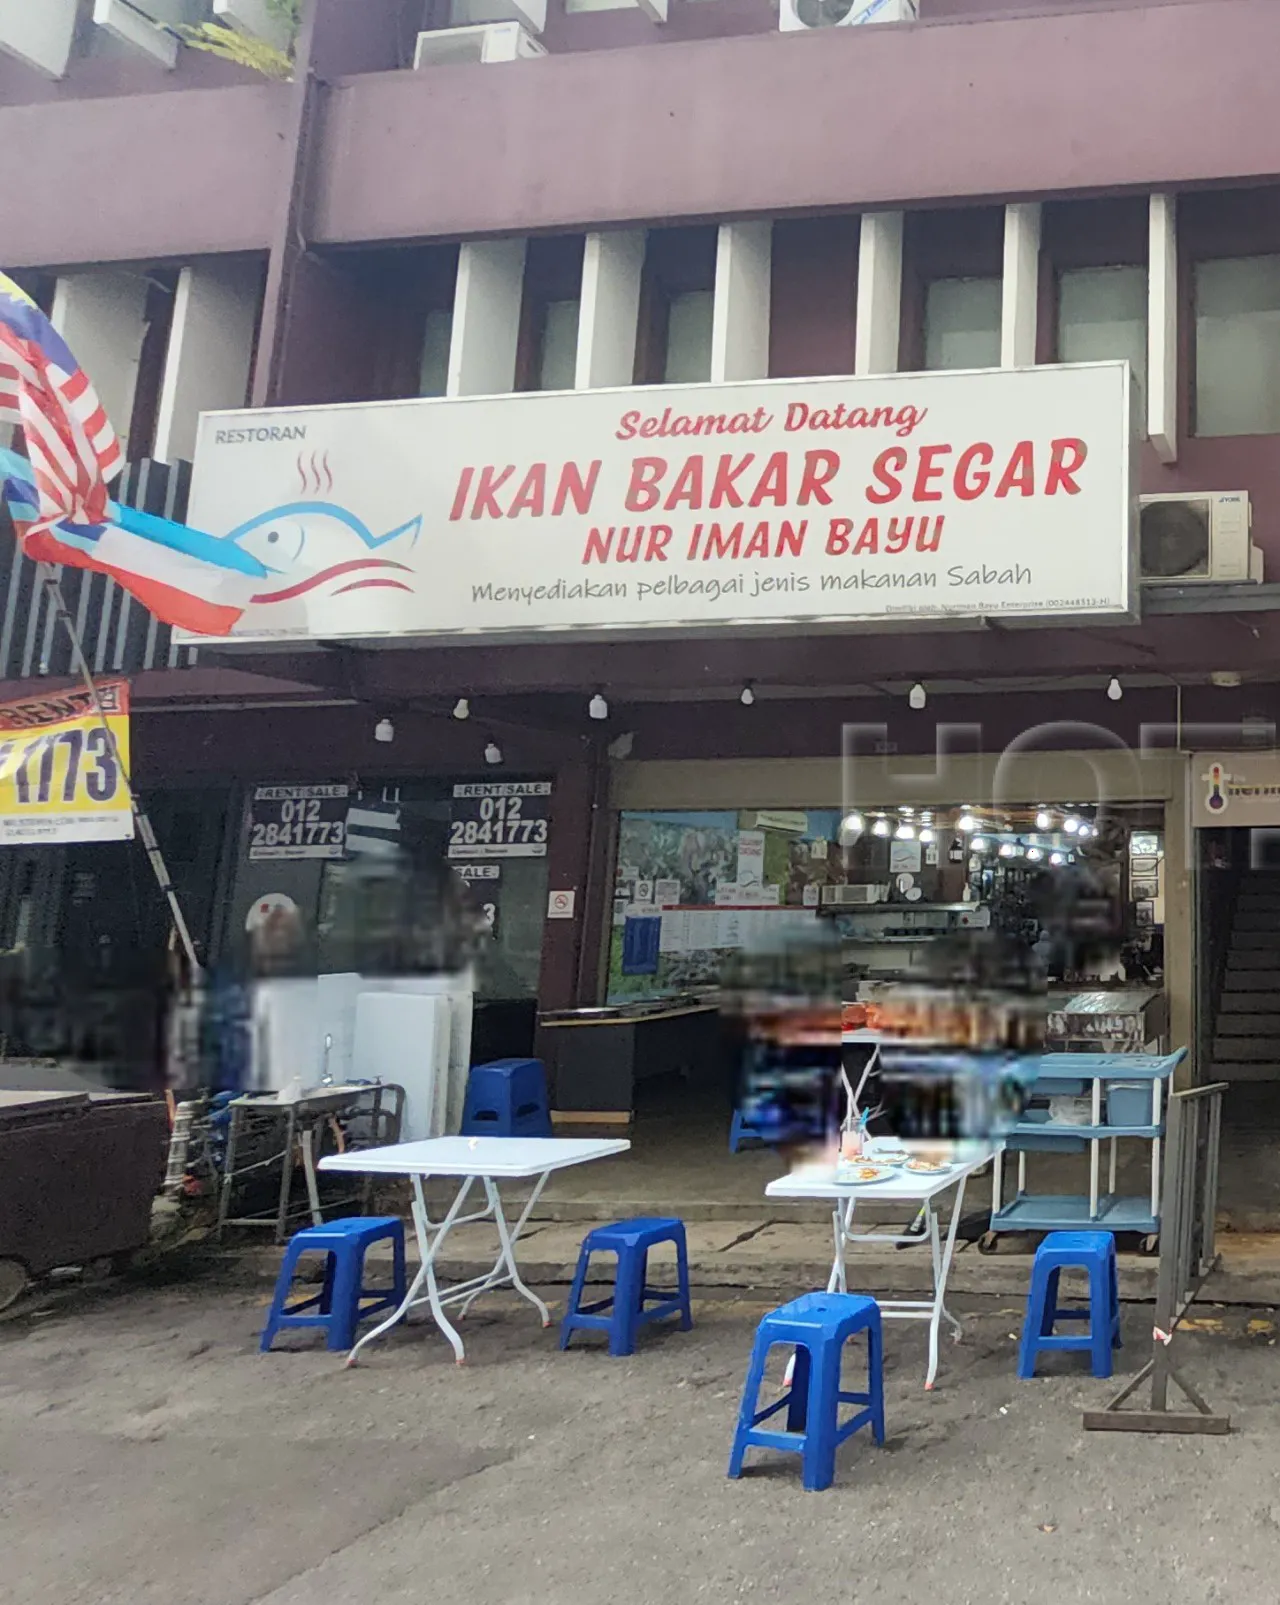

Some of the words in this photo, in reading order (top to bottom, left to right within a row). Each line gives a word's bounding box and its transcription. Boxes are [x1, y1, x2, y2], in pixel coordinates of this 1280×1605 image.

[616, 407, 774, 440] Selamat
[785, 402, 927, 437] Datang
[215, 426, 306, 443] RESTORAN
[450, 461, 602, 521] IKAN
[625, 449, 841, 513] BAKAR
[865, 438, 1086, 504] SEGAR
[582, 525, 673, 563] NUR
[687, 520, 808, 560] IMAN
[826, 515, 945, 555] BAYU
[471, 578, 627, 605] Menyediakan
[637, 574, 743, 602] pelbagai
[750, 571, 811, 598] jenis
[821, 570, 937, 591] makanan
[946, 563, 1032, 587] Sabah
[464, 785, 502, 796] RENT
[281, 799, 321, 823] 012
[480, 797, 522, 820] 012
[251, 821, 344, 846] 2841773
[449, 819, 547, 844] 2841773
